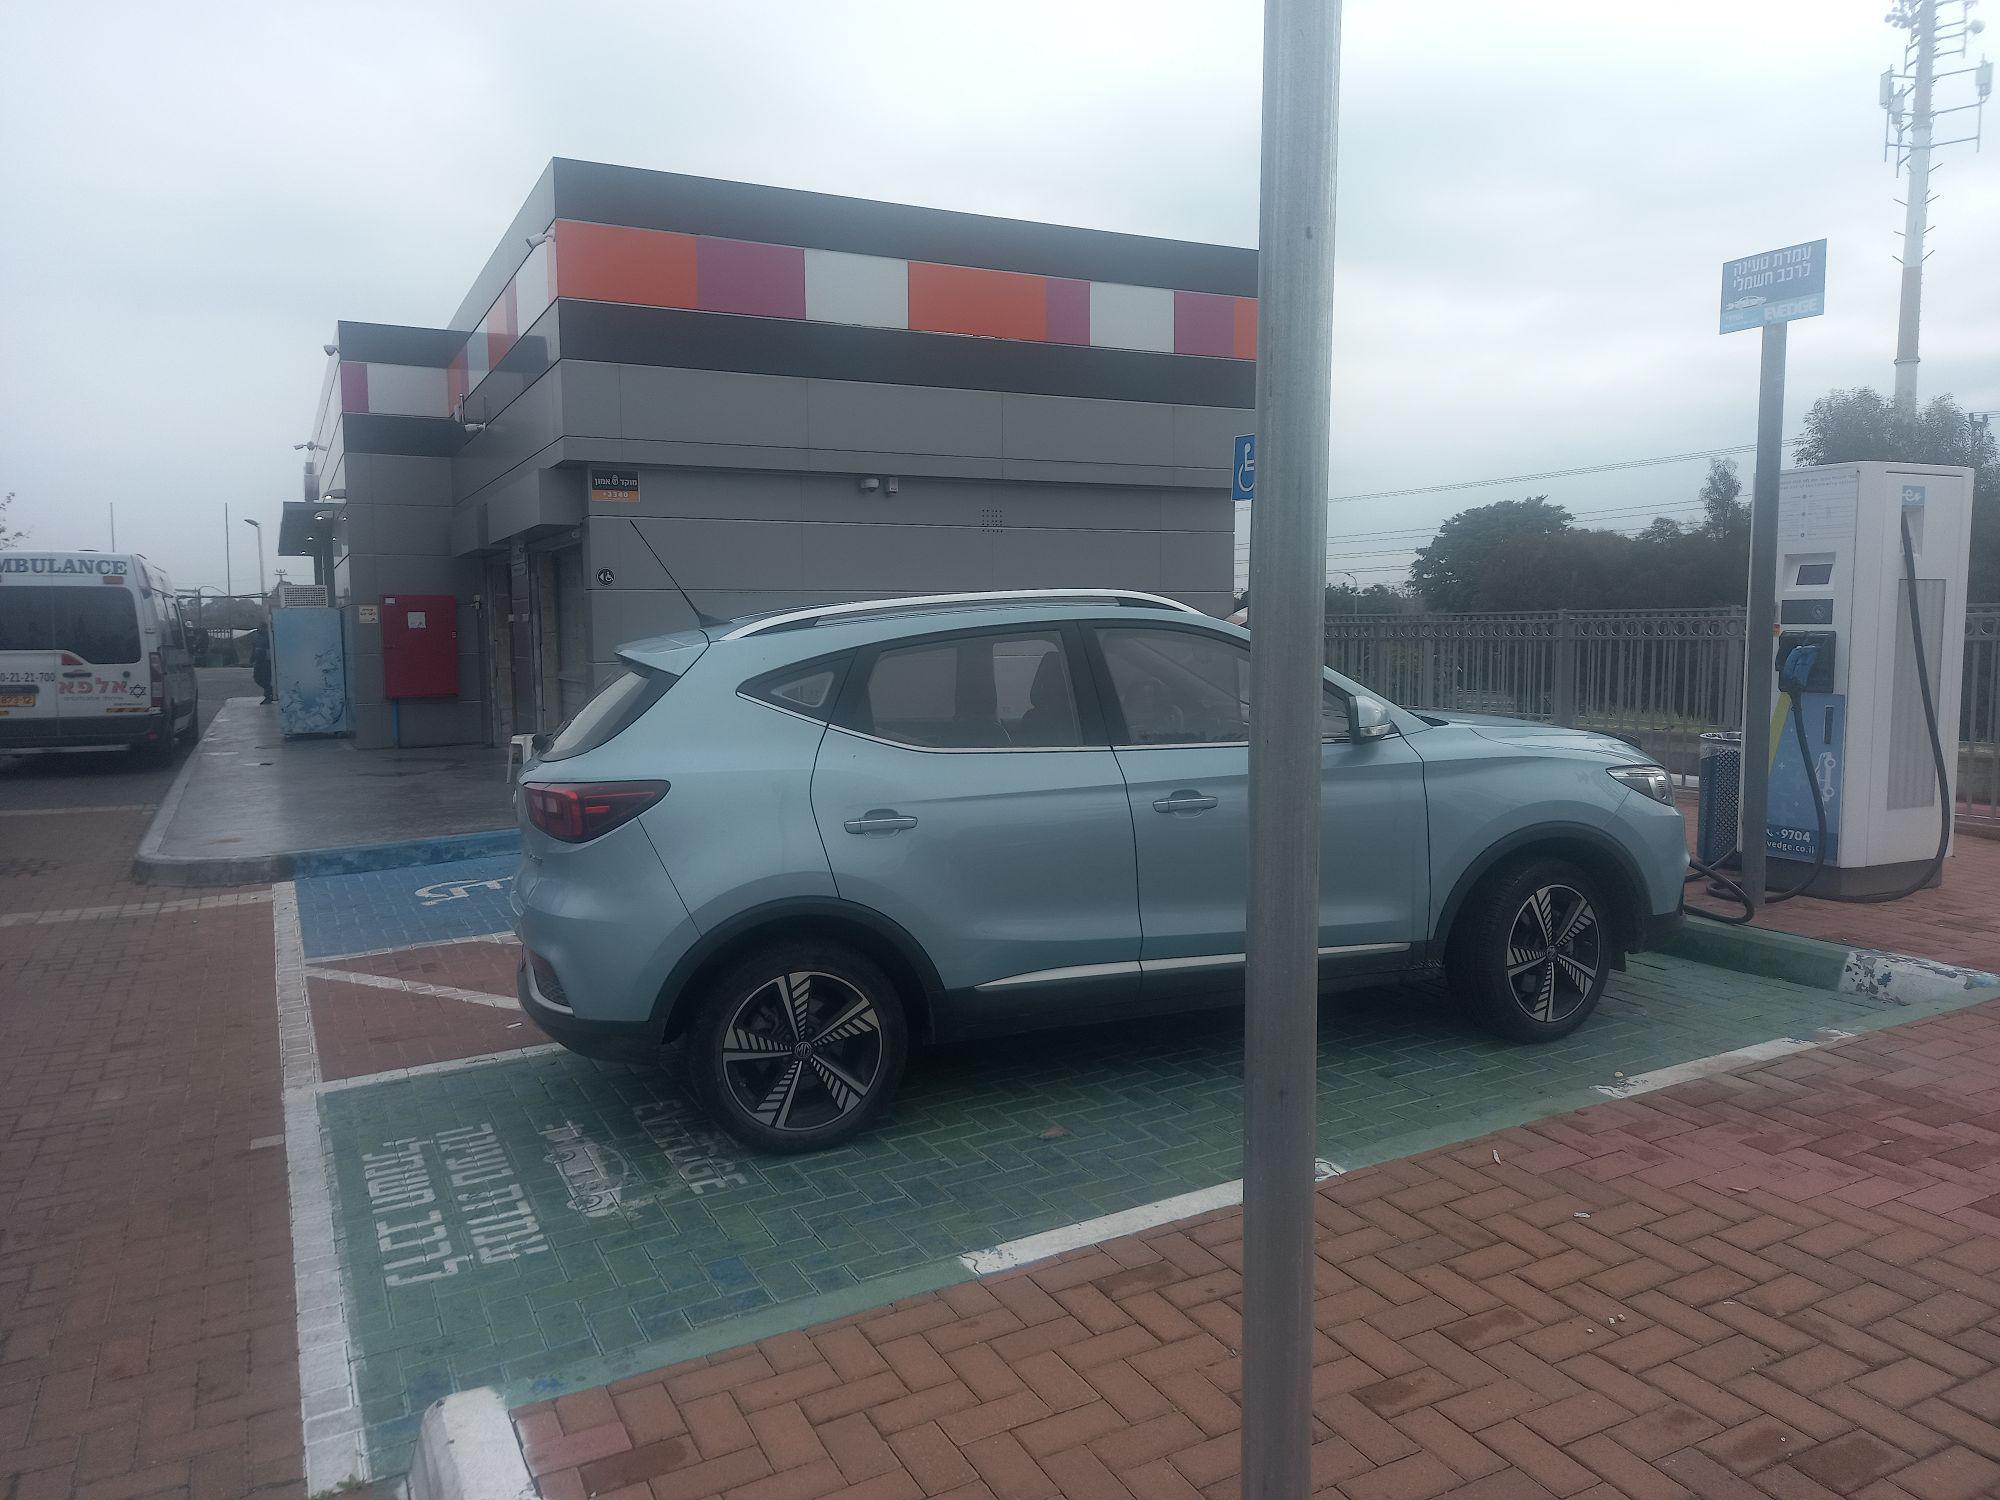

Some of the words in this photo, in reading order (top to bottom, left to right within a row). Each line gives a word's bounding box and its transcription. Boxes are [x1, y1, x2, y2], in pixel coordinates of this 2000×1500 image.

[1733, 255, 1769, 277] טעינה
[1773, 245, 1812, 267] עמדת
[1733, 271, 1773, 292] חשמלי
[1777, 261, 1812, 283] לרכב
[594, 477, 611, 486] אמון
[619, 478, 638, 487] מוקד
[58, 677, 129, 695] אלפא
[795, 1044, 812, 1058] MG
[376, 1209, 473, 1287] לרכב
